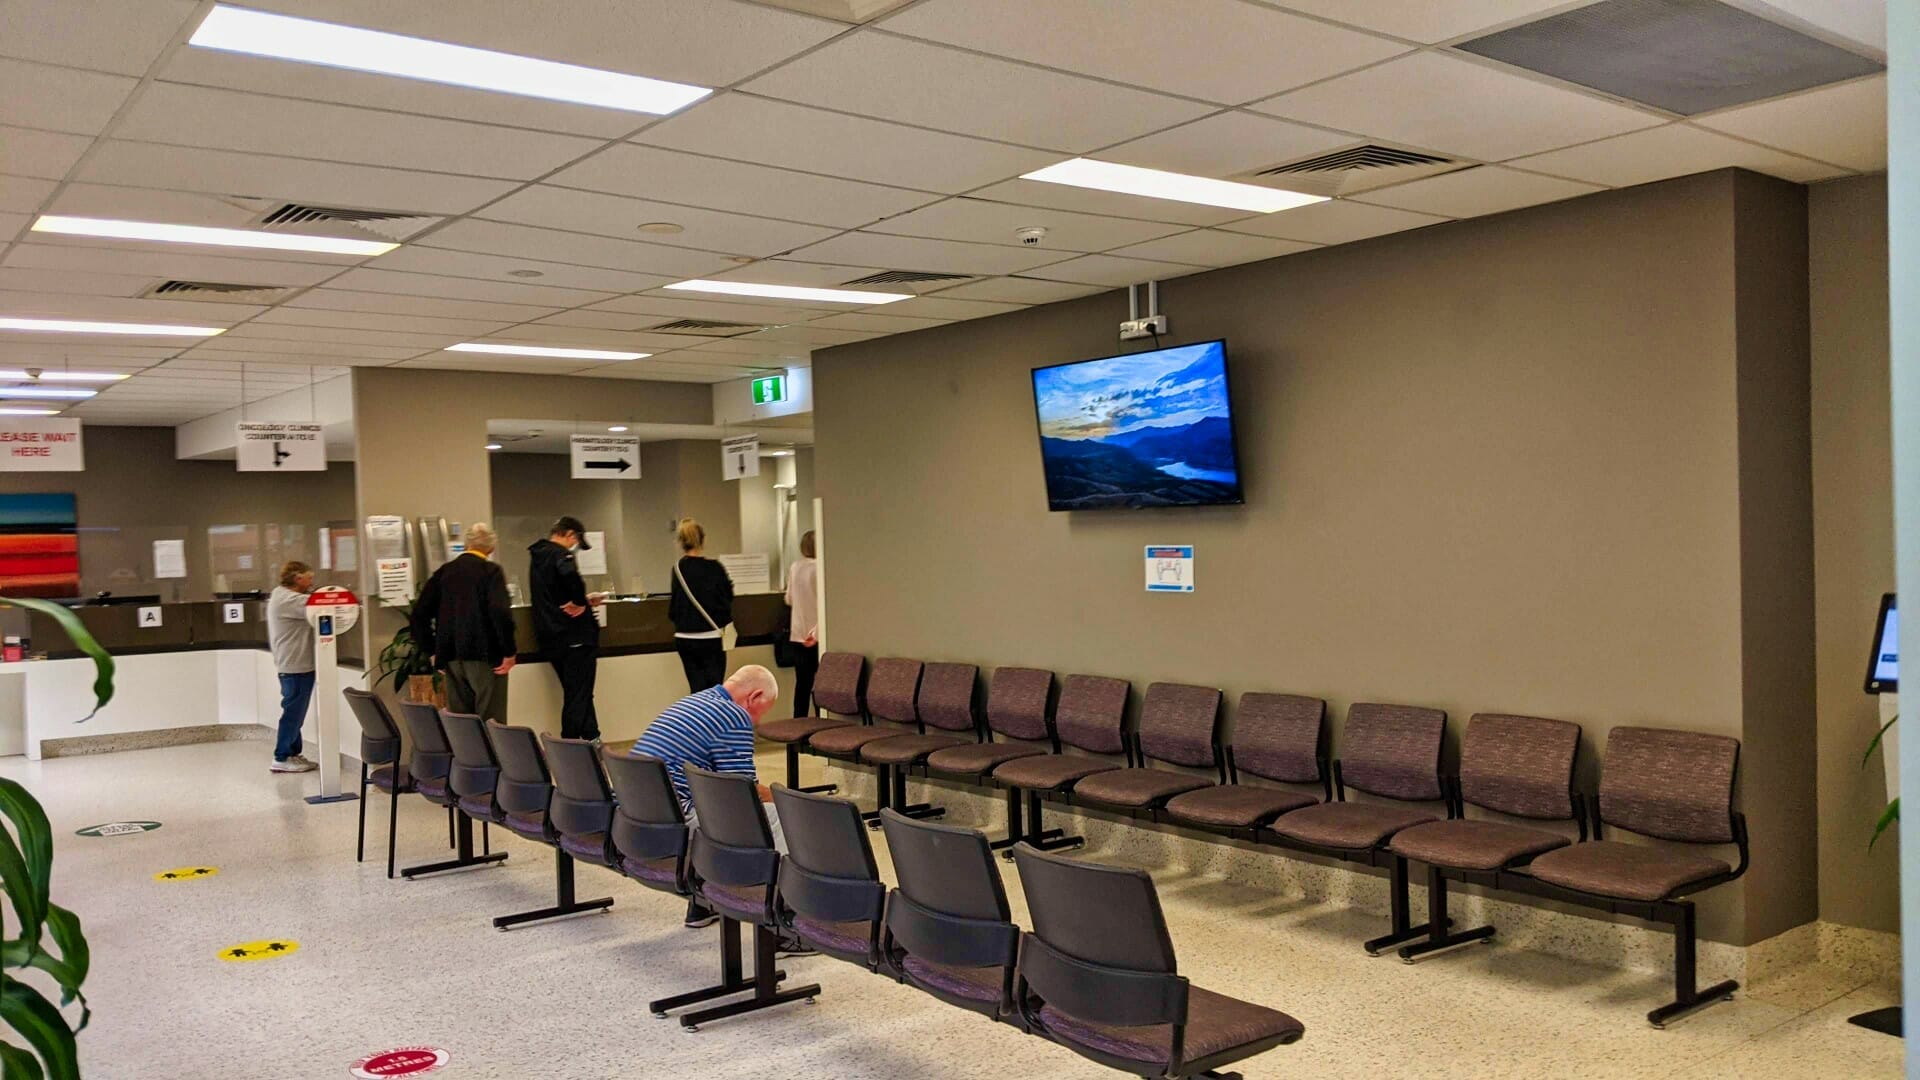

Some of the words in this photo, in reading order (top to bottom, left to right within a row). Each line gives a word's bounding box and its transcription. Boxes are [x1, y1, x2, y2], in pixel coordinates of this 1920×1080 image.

[43, 432, 77, 443] WAIT
[11, 446, 51, 457] HERE
[145, 611, 156, 622] A
[230, 608, 239, 619] B
[370, 1056, 434, 1072] METRES
